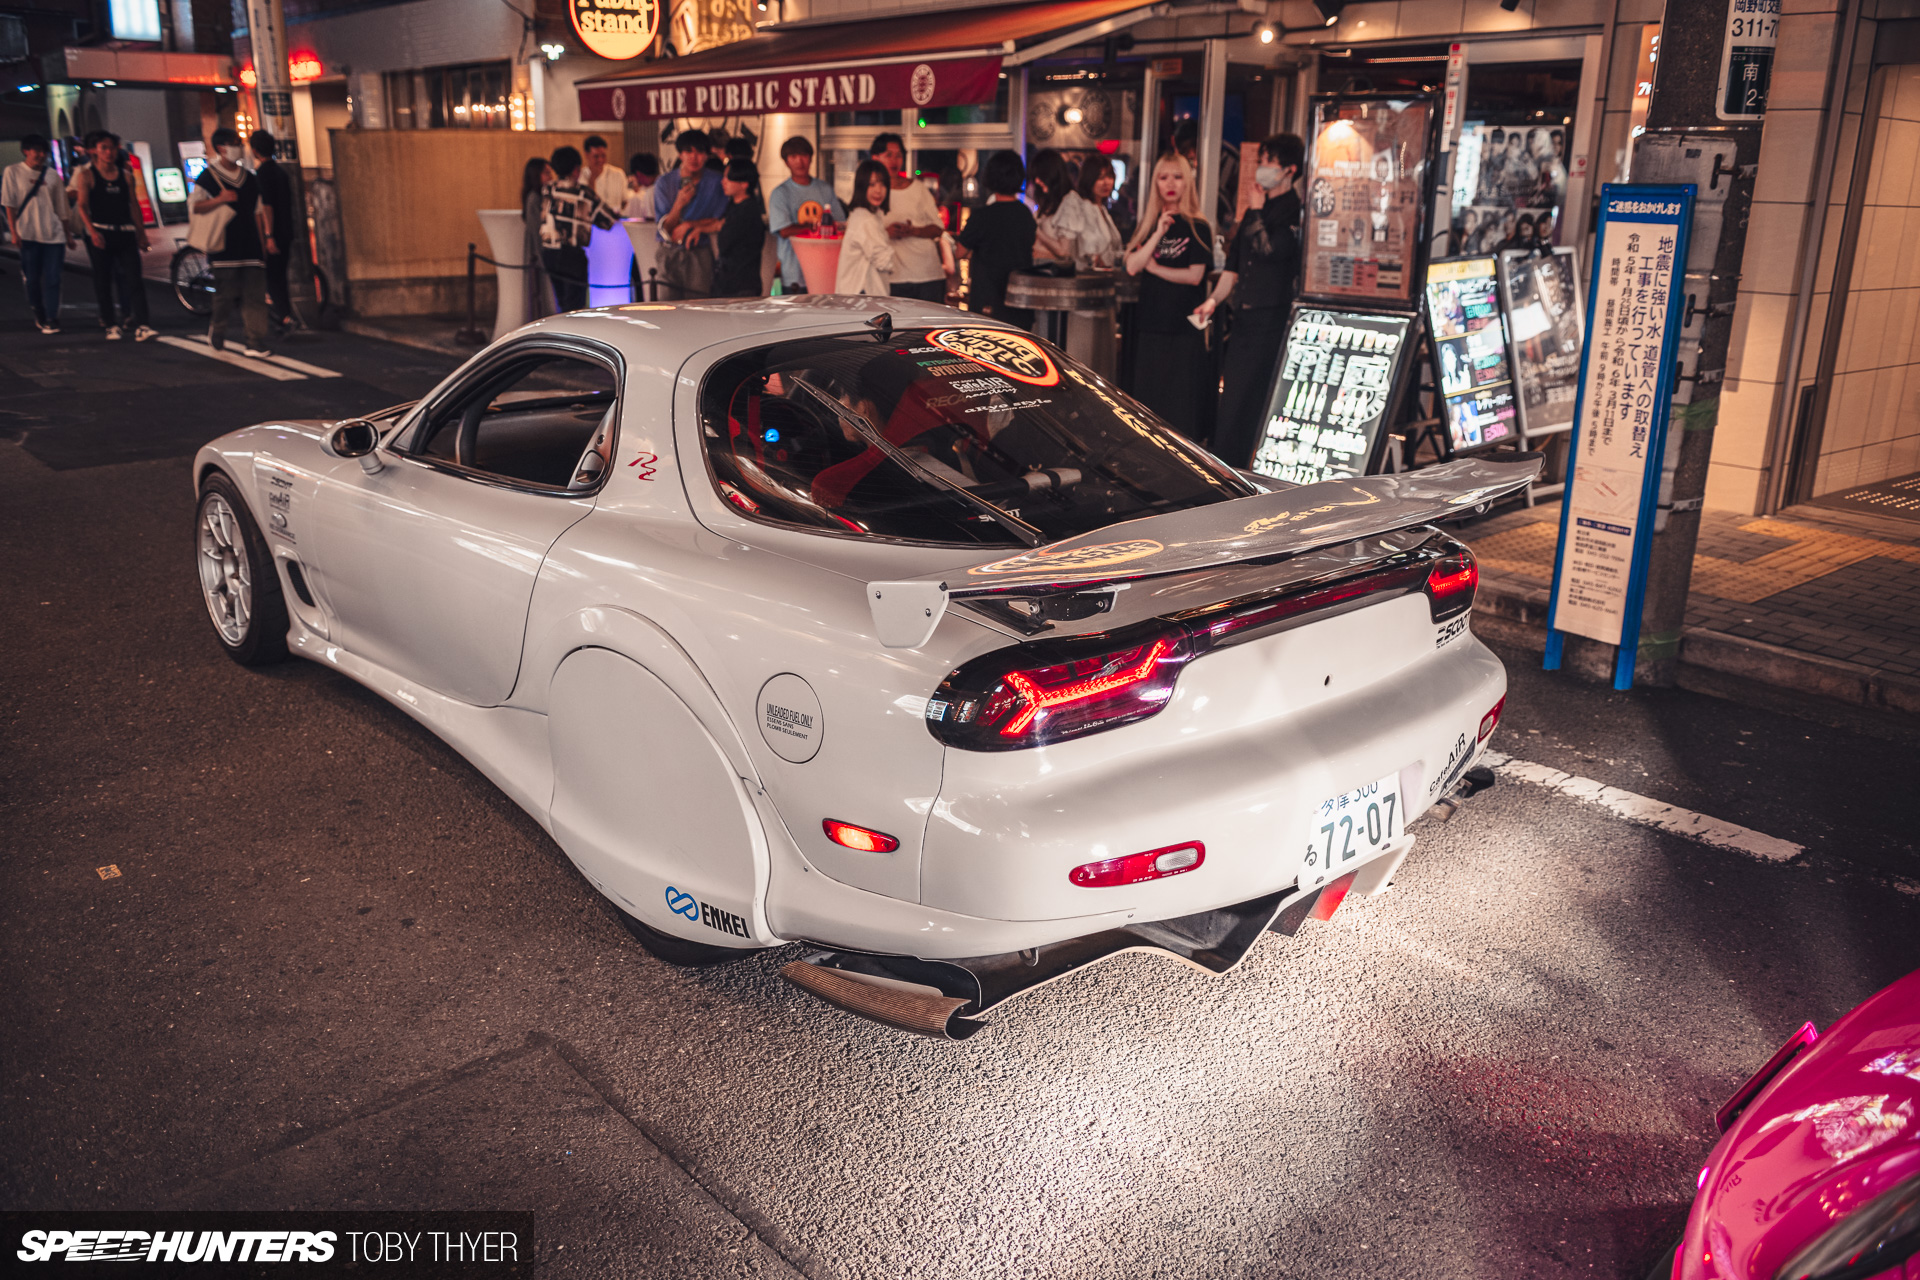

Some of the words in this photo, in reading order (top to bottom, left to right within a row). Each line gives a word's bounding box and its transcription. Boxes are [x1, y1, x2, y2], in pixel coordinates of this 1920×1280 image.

[580, 9, 650, 33] stand
[646, 88, 687, 115] THE
[695, 79, 778, 113] PUBLIC
[788, 73, 877, 109] STAND
[1607, 200, 1681, 216] ご迷惑をおかけします
[1619, 256, 1655, 421] 工事を行っています
[908, 347, 948, 355] SCOO
[927, 363, 986, 377] SYNTIUM
[766, 703, 789, 719] UNLEADED
[790, 710, 800, 723] FUEL
[801, 714, 813, 726] ONLY
[782, 727, 808, 740] SEULEMENT
[1304, 843, 1318, 867] る
[1320, 792, 1396, 870] 72-07
[700, 901, 751, 939] ENKEI
